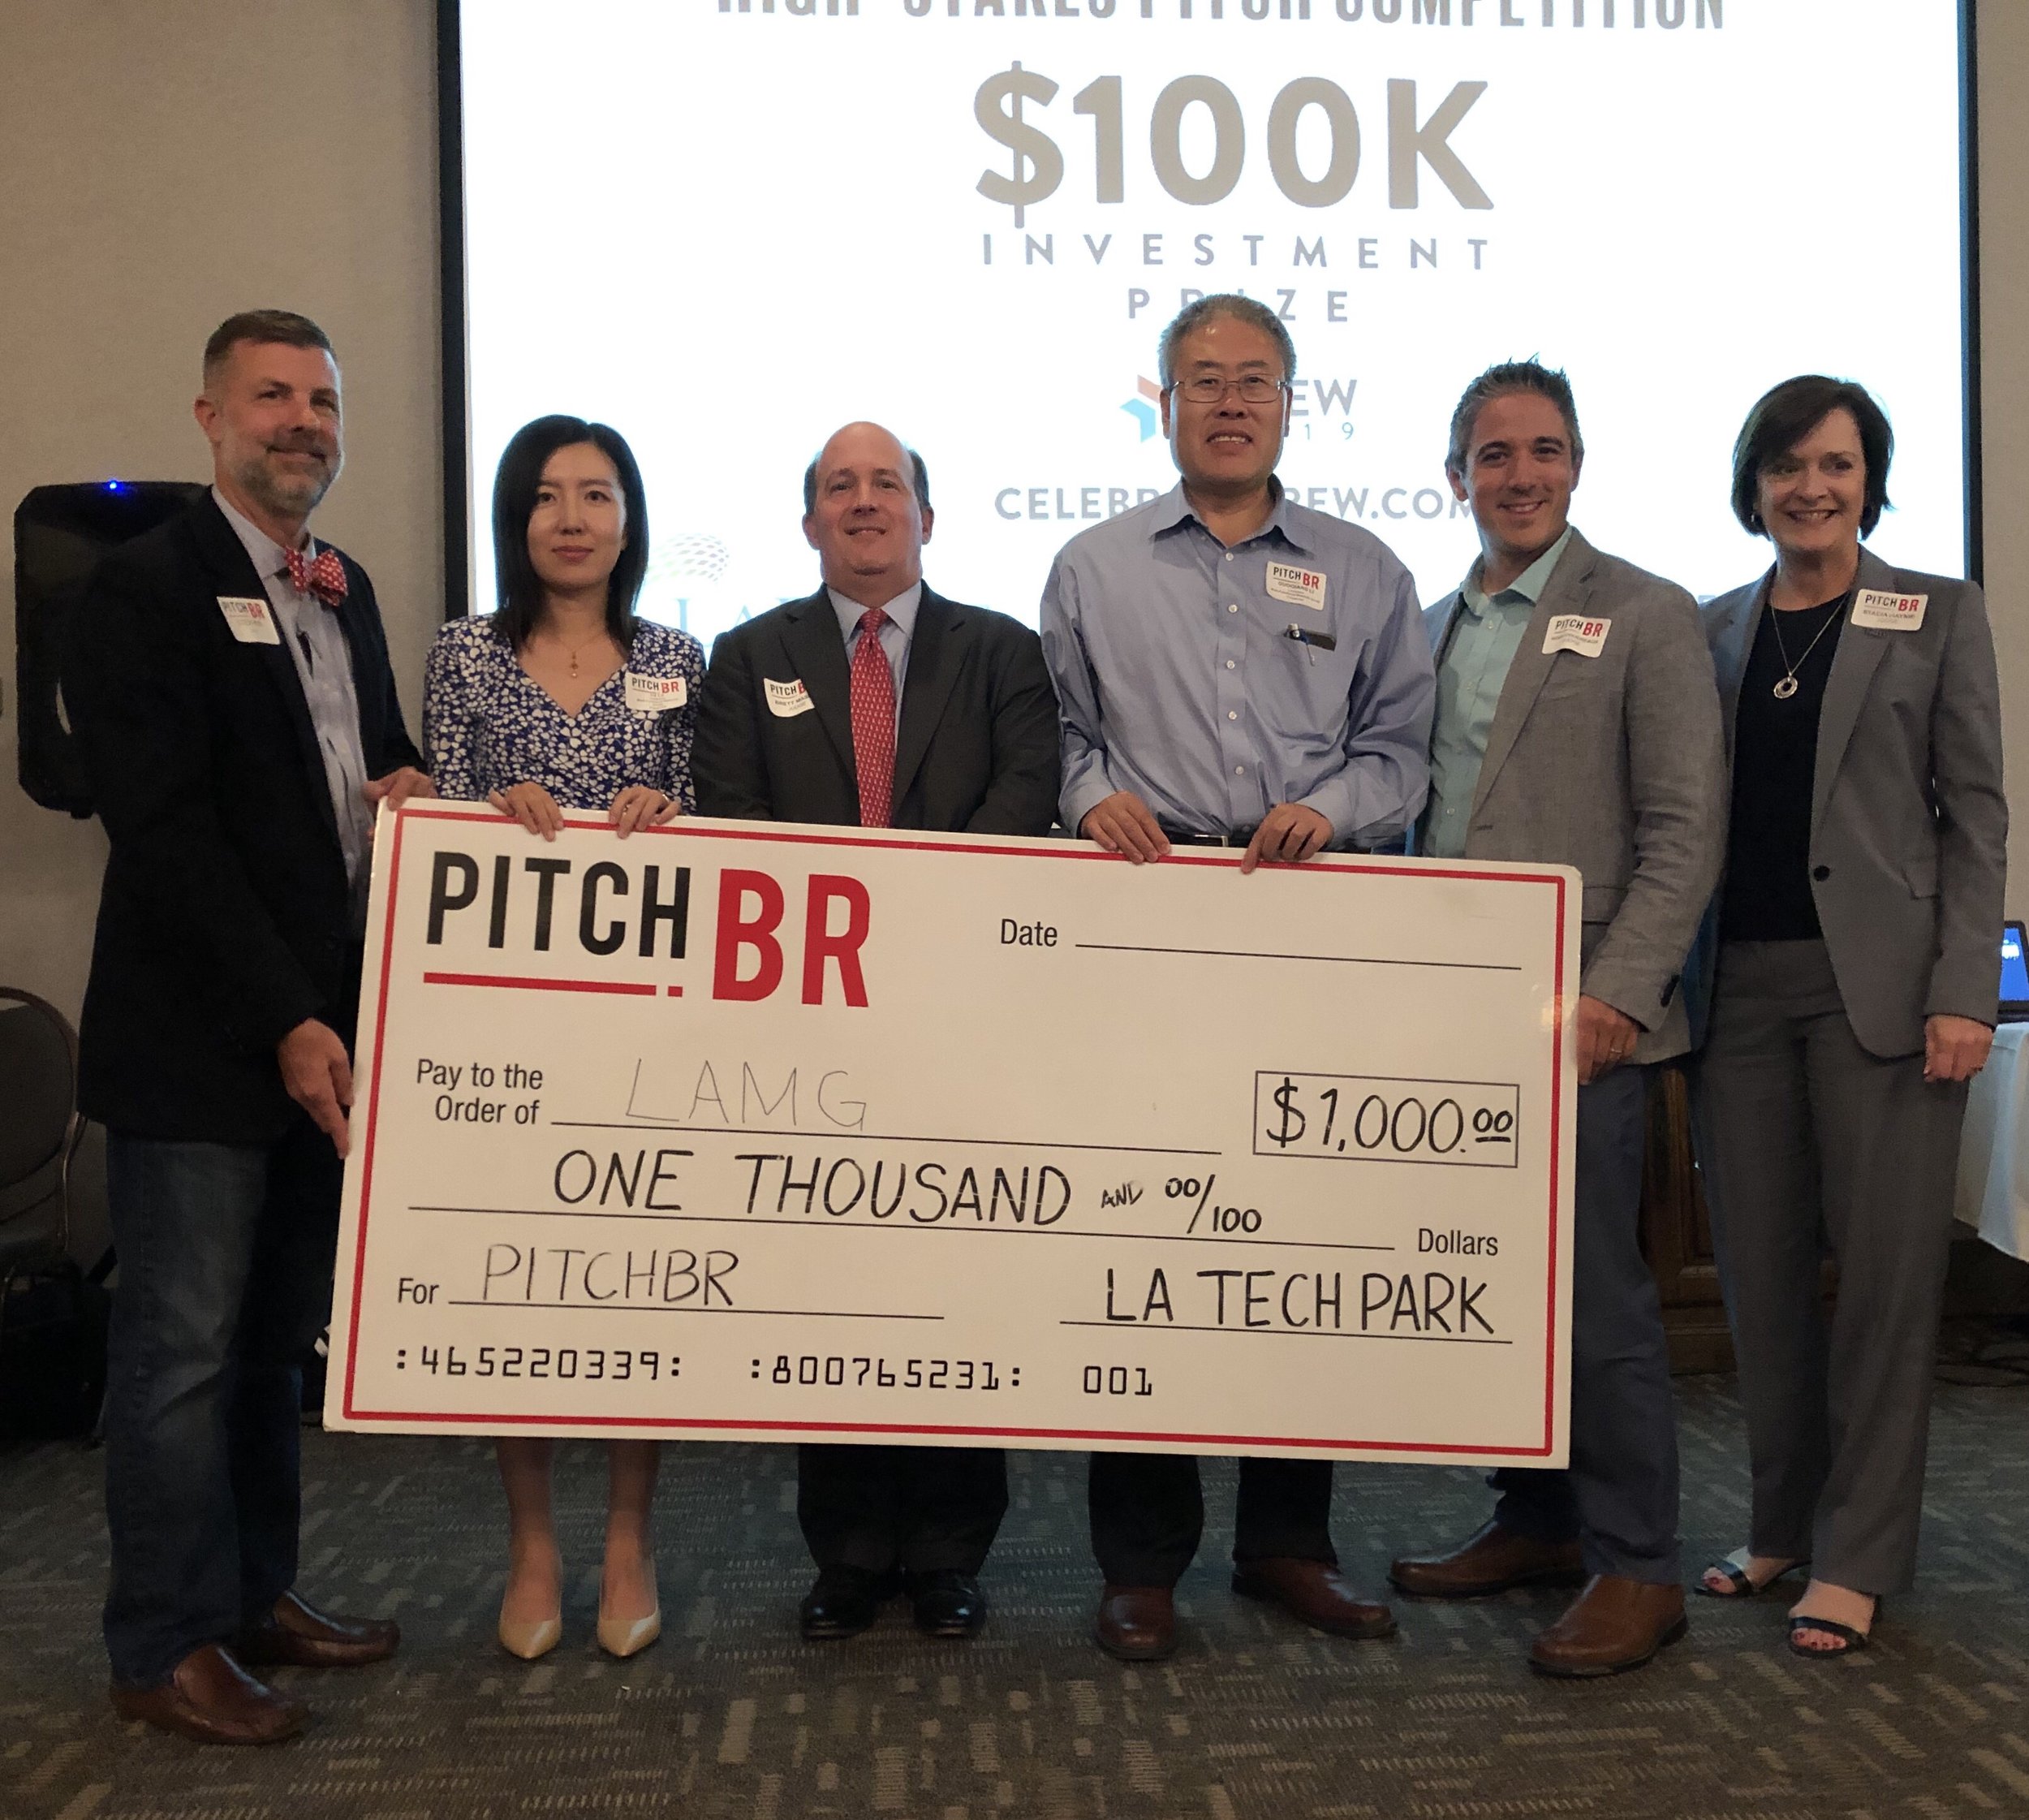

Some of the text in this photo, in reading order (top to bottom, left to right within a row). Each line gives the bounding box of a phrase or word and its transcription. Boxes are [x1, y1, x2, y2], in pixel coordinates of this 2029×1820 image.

[973, 60, 1494, 229] $100K
[982, 233, 1488, 271] INVESTMENT
[1128, 288, 1347, 322] PZE
[798, 683, 806, 694] B
[426, 851, 691, 959] PITCH
[1001, 919, 1058, 947] Date
[417, 1059, 544, 1089] Pay to the
[435, 1096, 540, 1125] Order of
[626, 1058, 867, 1131] LAMG
[554, 1149, 693, 1210] ONE
[734, 1154, 1071, 1226] THOUSAND
[1101, 1180, 1144, 1210] AND
[1417, 1228, 1499, 1257] Dollars
[398, 1278, 439, 1305] For
[483, 1244, 739, 1306] PITCHBR
[1107, 1268, 1494, 1335] LA TECH PARK
[1083, 1365, 1152, 1396] 001
